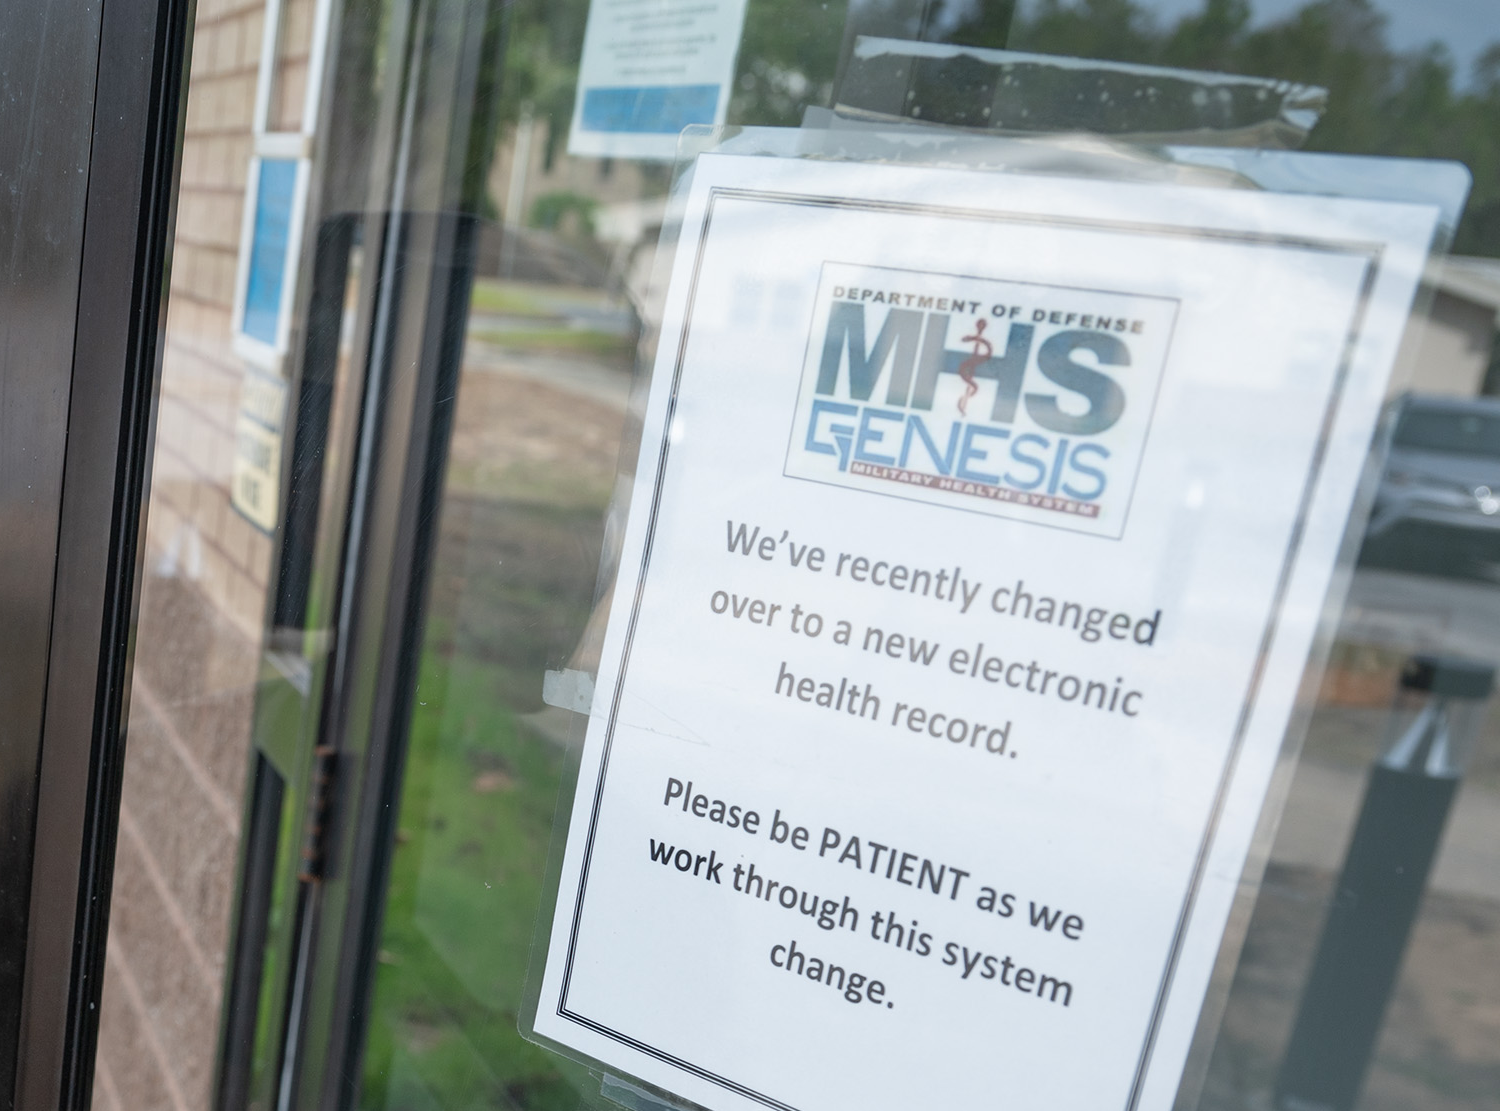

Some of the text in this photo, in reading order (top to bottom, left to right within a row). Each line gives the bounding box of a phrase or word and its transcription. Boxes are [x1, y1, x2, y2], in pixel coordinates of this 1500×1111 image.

[832, 285, 1146, 335] DEPARTMENT OF DEFENSE
[815, 300, 1132, 436] MHS
[804, 398, 1111, 501] GENESIS
[851, 461, 1096, 517] MILITARY HEALTH SYSTEM
[835, 551, 981, 614] recently
[991, 580, 1163, 647] changed
[709, 588, 1144, 718] over to a new electronic
[774, 661, 1018, 760] health record.
[663, 776, 1085, 941] Please be PATIENT as we
[649, 837, 1075, 1008] work through this system
[769, 939, 896, 1010] change.
